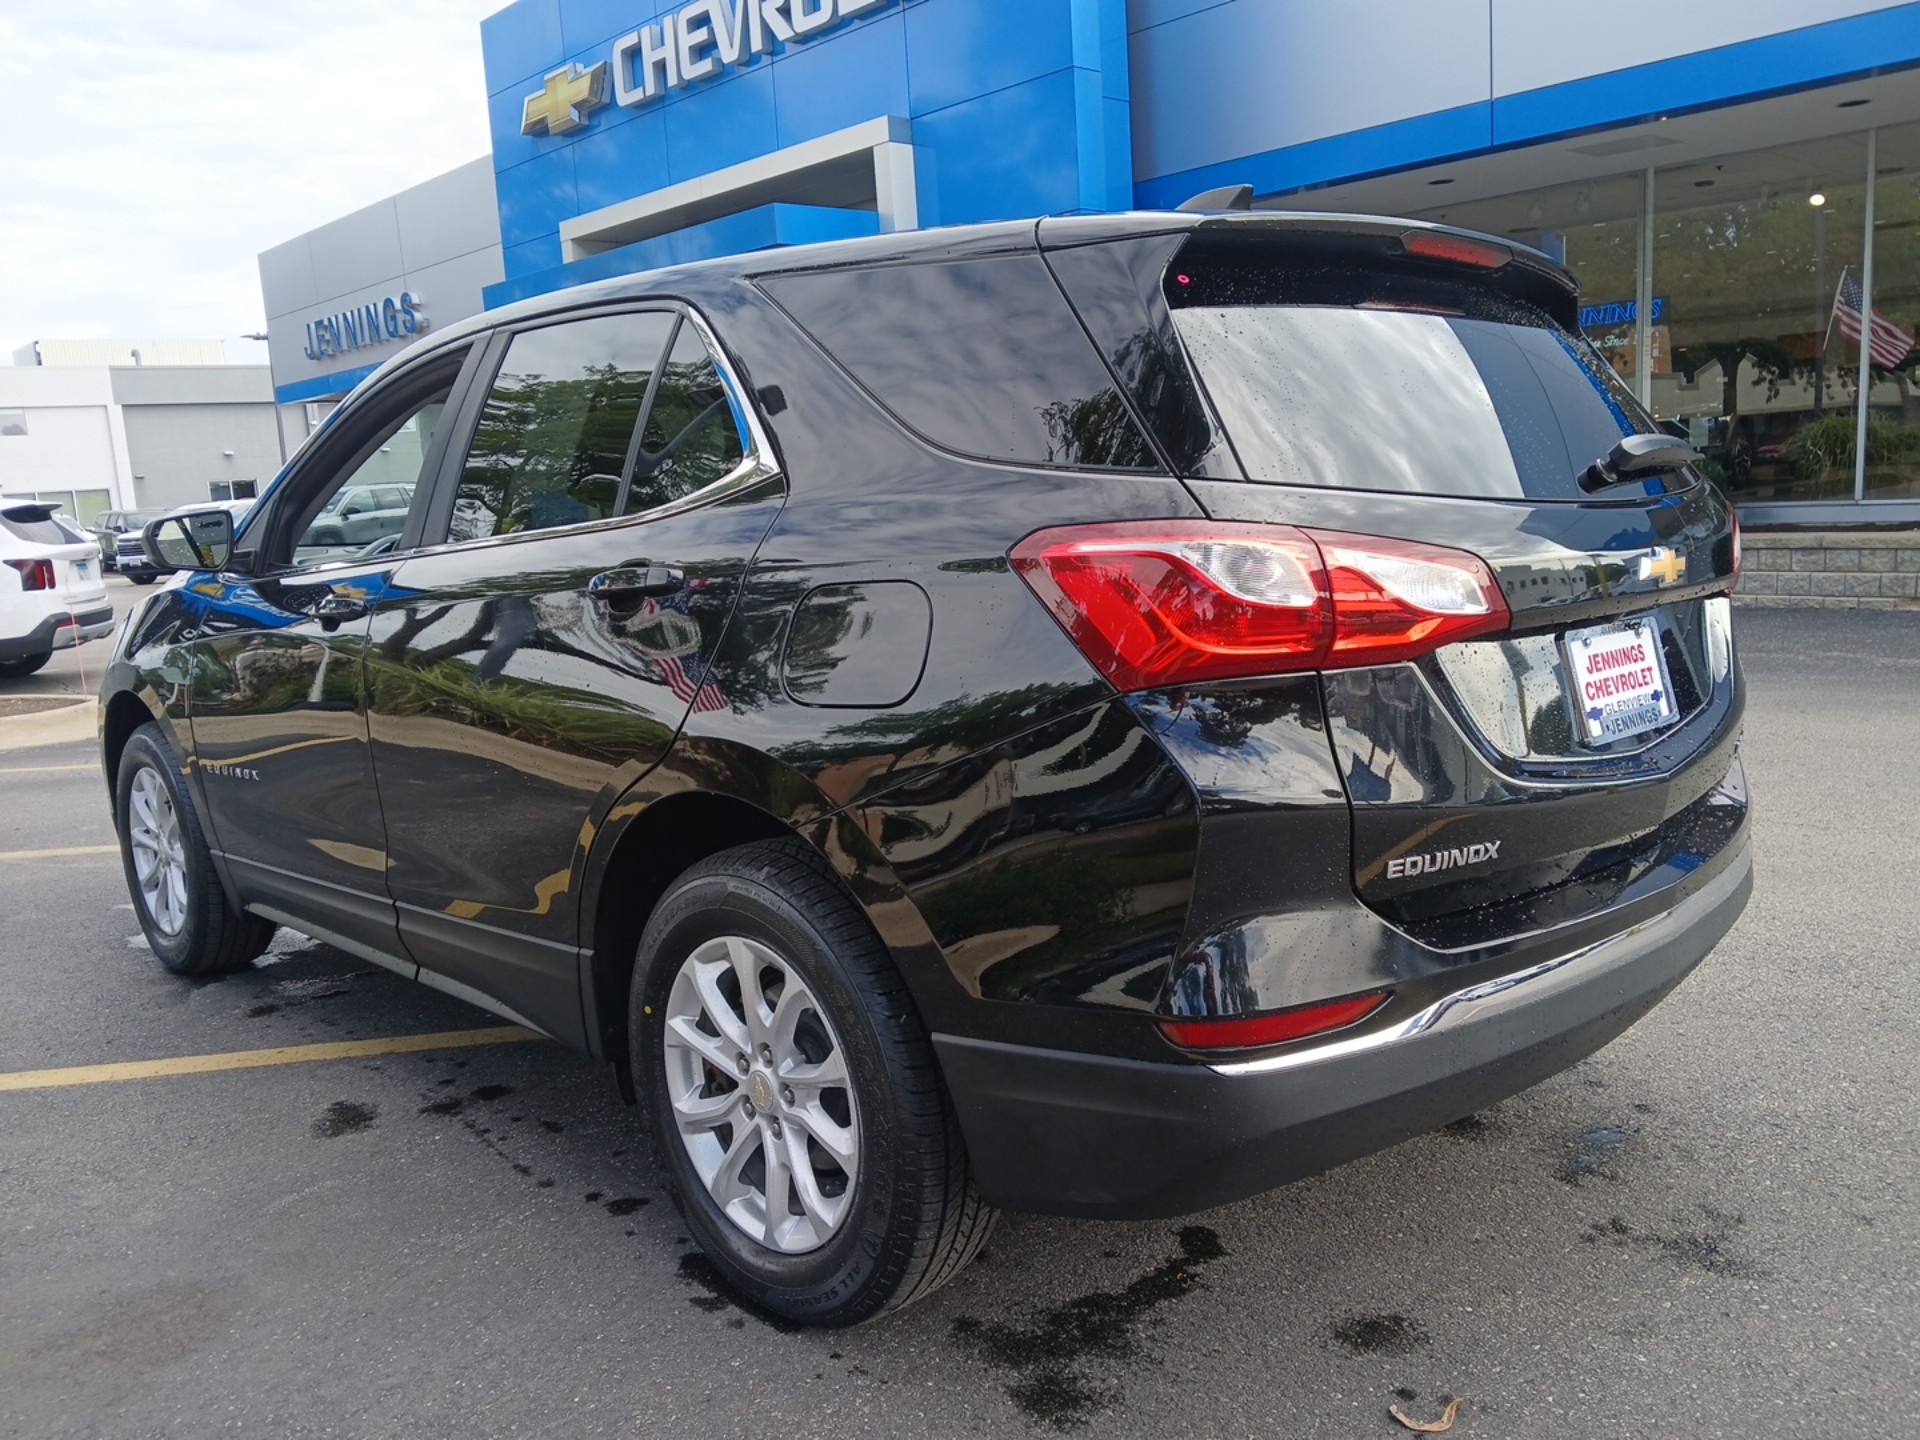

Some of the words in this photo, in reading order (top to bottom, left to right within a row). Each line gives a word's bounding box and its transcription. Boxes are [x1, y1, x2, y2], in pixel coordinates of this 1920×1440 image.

[612, 0, 886, 107] CHEVR
[304, 292, 421, 360] JENNINGS
[1586, 643, 1645, 674] JENNINGS
[1585, 666, 1654, 701] CHEVROLET
[1604, 692, 1650, 715] GLENVIEW
[1611, 707, 1659, 735] JENNINGS
[206, 763, 260, 780] EQUINOX
[1387, 840, 1501, 879] EQUINOX
